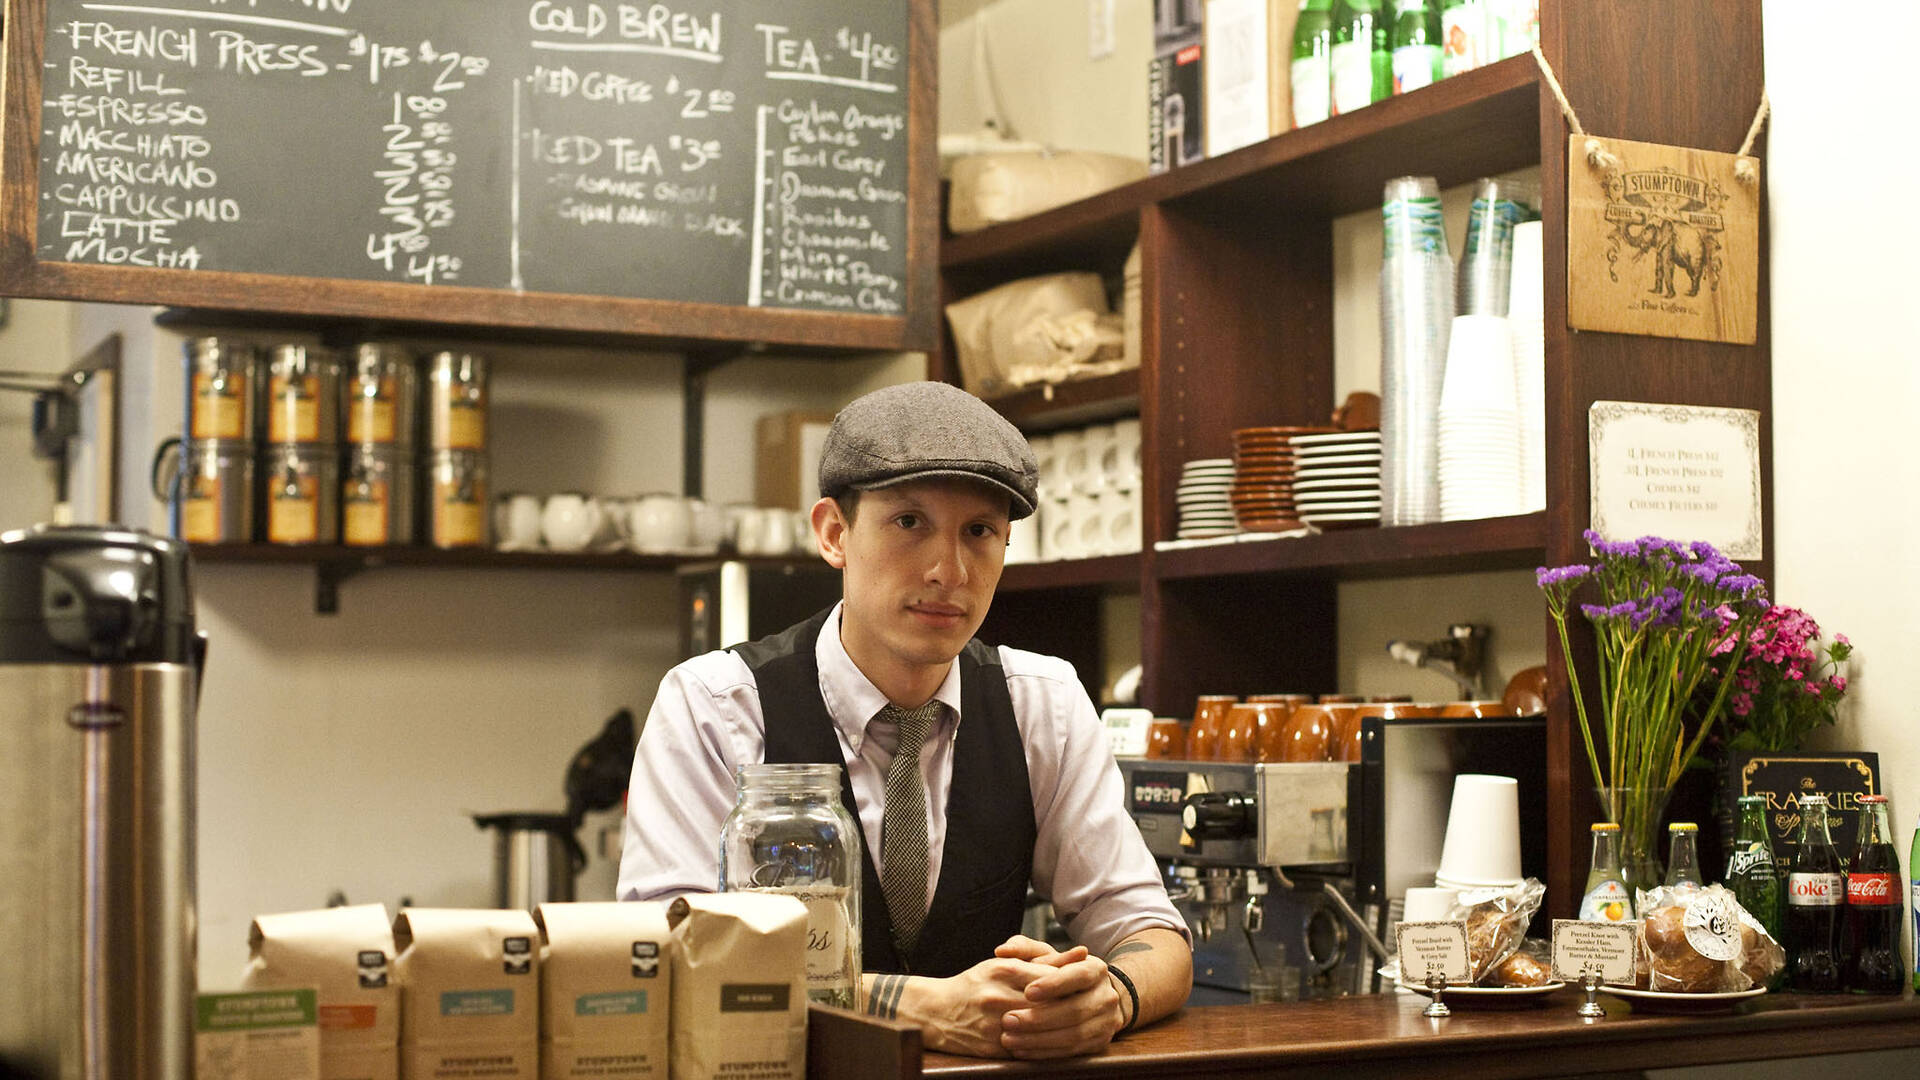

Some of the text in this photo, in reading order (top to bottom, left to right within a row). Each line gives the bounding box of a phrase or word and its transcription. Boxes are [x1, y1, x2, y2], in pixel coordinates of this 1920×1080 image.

[529, 1, 721, 53] COLD BREW
[68, 20, 197, 68] FRENCH
[209, 30, 328, 76] PRESS
[69, 56, 186, 94] REFILL
[59, 94, 208, 127] ESPRESSO
[59, 119, 211, 159] MACCHIATO
[55, 151, 217, 189] AMERICANO
[606, 137, 663, 176] TEA
[55, 183, 240, 222] CAPPUCCINO
[1631, 175, 1700, 198] STUMPTOWN
[61, 210, 178, 244] LATTE
[65, 238, 202, 270] MOCHA
[1754, 791, 1863, 811] RAKIES
[1736, 849, 1770, 871] Sprite
[1790, 880, 1828, 897] Coke
[1848, 878, 1889, 897] oca-Cola
